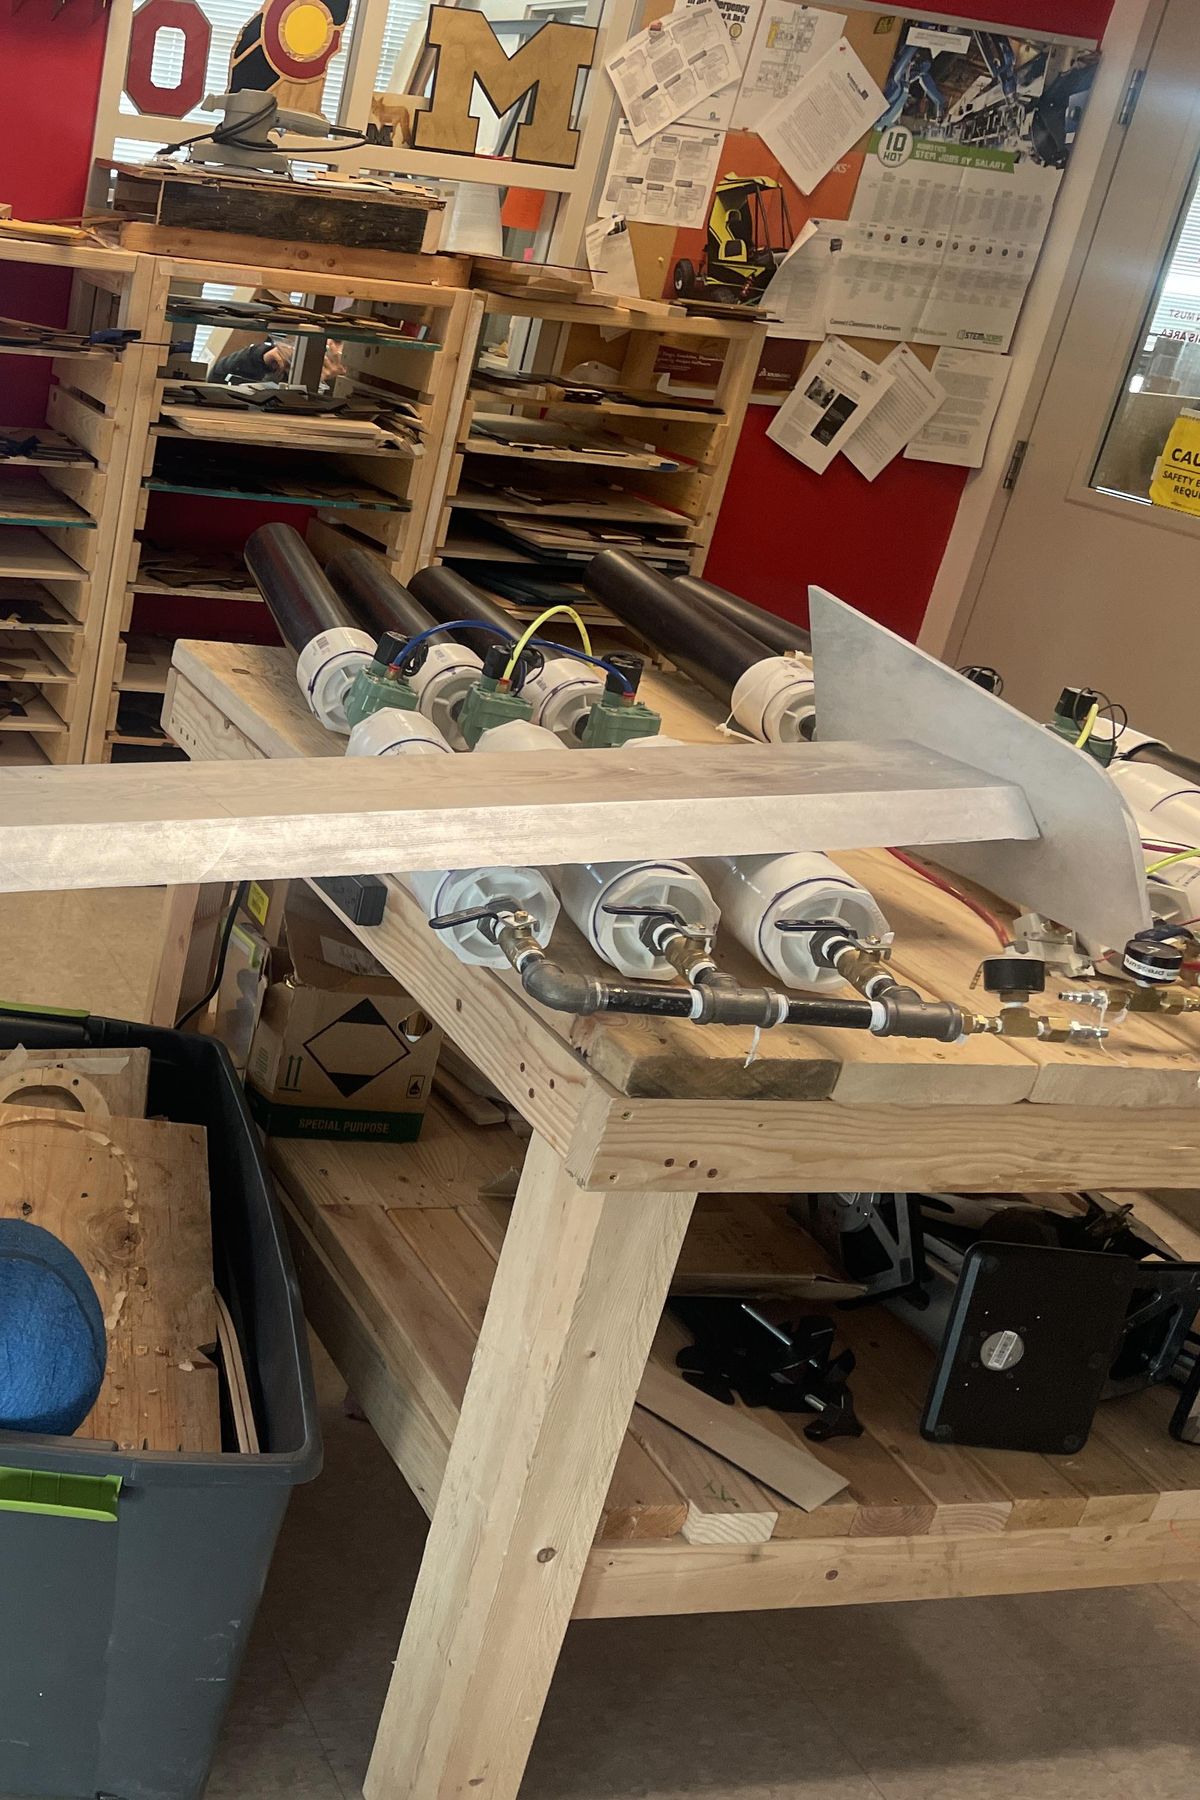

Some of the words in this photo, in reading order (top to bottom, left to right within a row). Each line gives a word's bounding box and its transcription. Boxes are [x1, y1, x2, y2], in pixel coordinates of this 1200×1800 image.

[413, 4, 598, 168] M
[886, 131, 907, 152] 10
[883, 151, 903, 162] HOT
[914, 150, 937, 161] STEM
[938, 153, 959, 164] JOBS
[961, 156, 974, 166] BY
[974, 158, 1007, 171] SALARY
[1162, 470, 1194, 486] SAFETY
[297, 1118, 340, 1131] SPECIAL
[343, 1120, 390, 1134] PURPOSE
